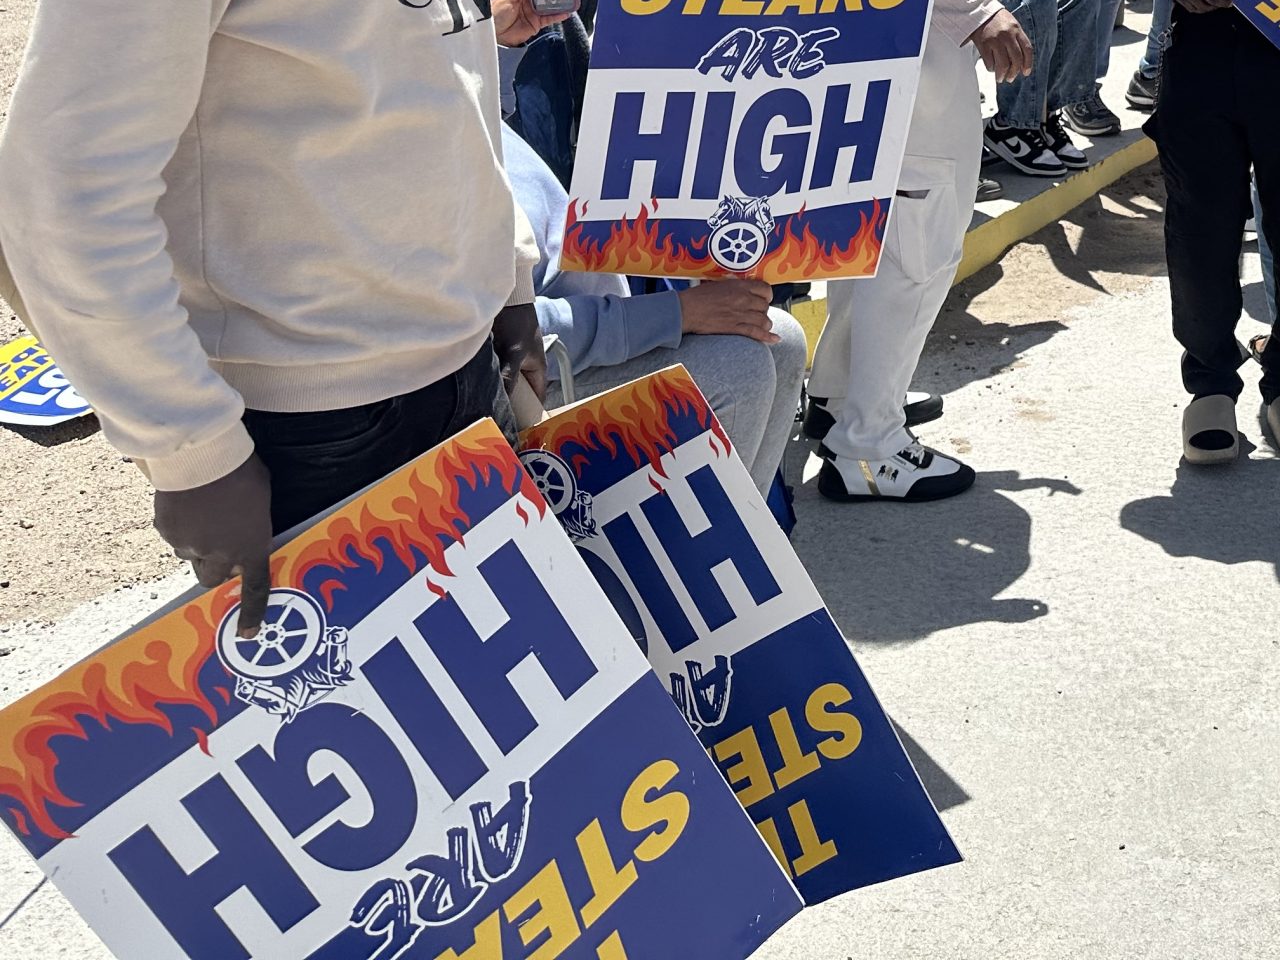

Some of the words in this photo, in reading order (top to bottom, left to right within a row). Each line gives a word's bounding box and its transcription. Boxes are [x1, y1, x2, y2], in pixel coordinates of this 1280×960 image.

[695, 26, 840, 83] ARE
[600, 79, 892, 201] HIGH
[575, 464, 783, 657] HI
[106, 538, 599, 960] HIGH
[706, 683, 863, 808] STE
[350, 780, 532, 960] ARE
